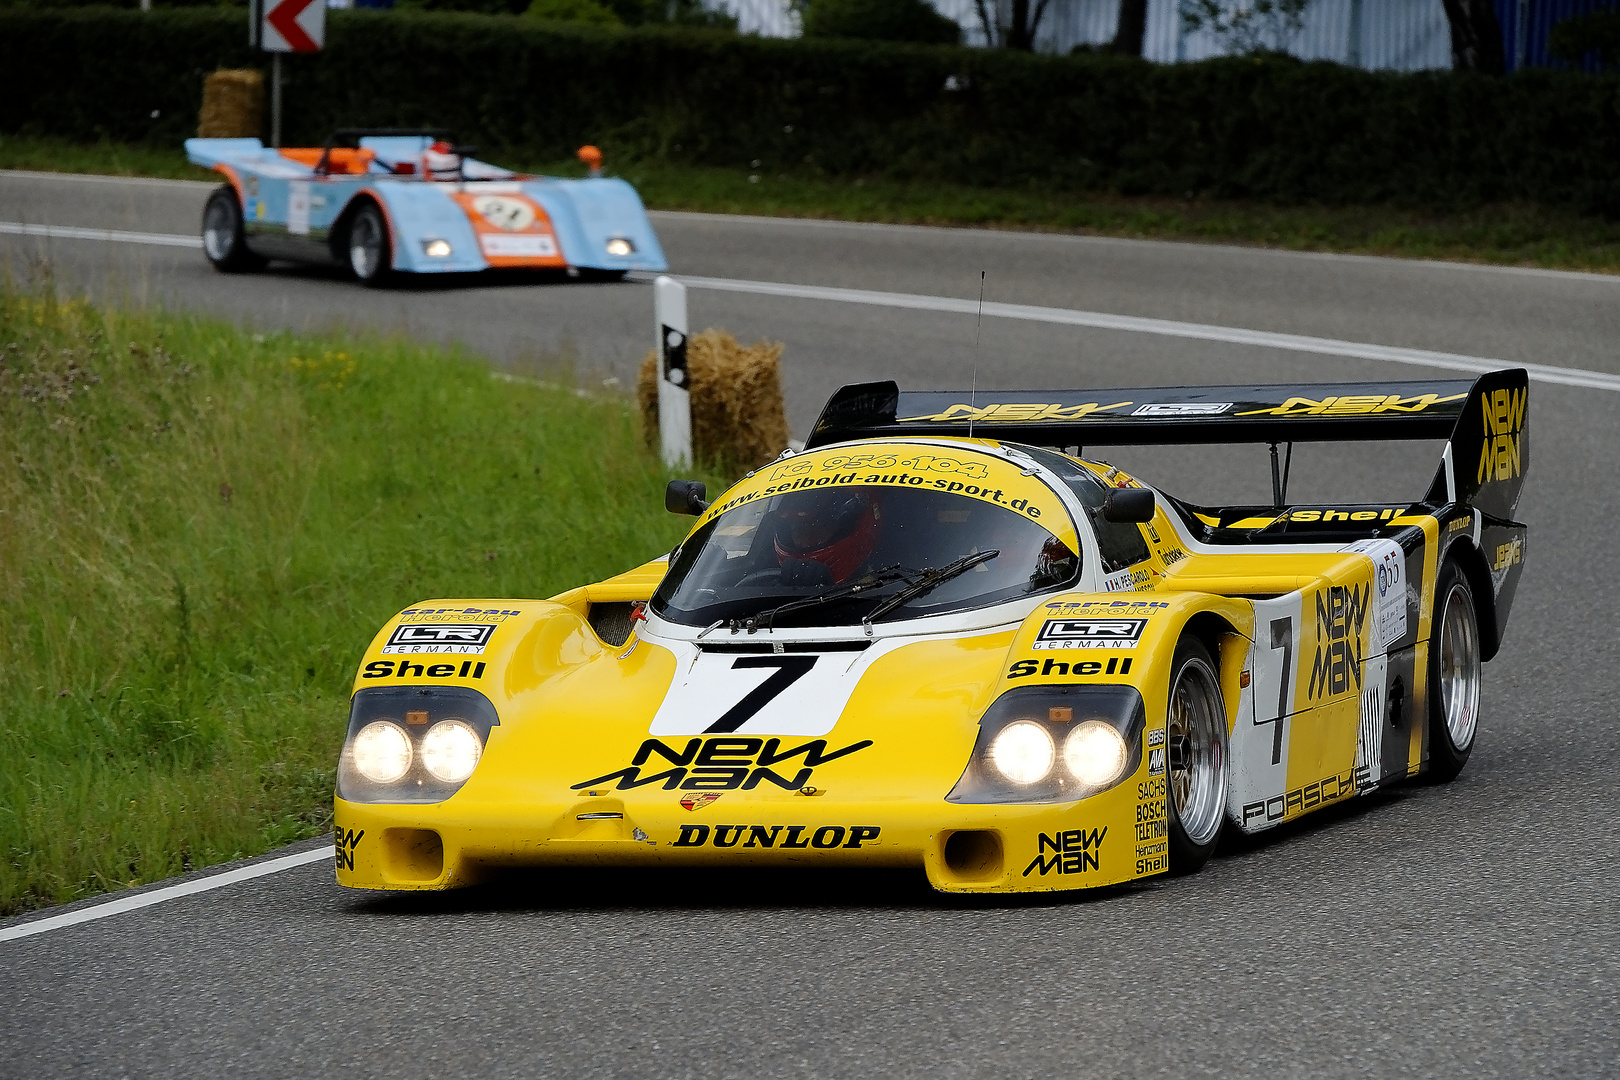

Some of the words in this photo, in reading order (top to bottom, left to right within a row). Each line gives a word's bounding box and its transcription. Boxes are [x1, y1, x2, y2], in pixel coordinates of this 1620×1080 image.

[707, 472, 1042, 519] www.seibold-auto-sport.de
[1290, 508, 1406, 522] Shell
[400, 612, 509, 623] Herold
[1047, 606, 1160, 616] Herold
[382, 645, 486, 654] GERMANY
[1032, 640, 1138, 650] GERMANY
[362, 660, 487, 679] Shell
[1007, 657, 1134, 679] Shell
[701, 655, 820, 734] 7
[1269, 616, 1293, 766] 7
[1148, 728, 1165, 747] BBS
[1137, 777, 1166, 800] SACHS
[1242, 764, 1372, 828] PORSCHE
[1136, 799, 1167, 822] BOSCH
[672, 824, 882, 849] DUNLOP
[1135, 854, 1168, 875] Shell
